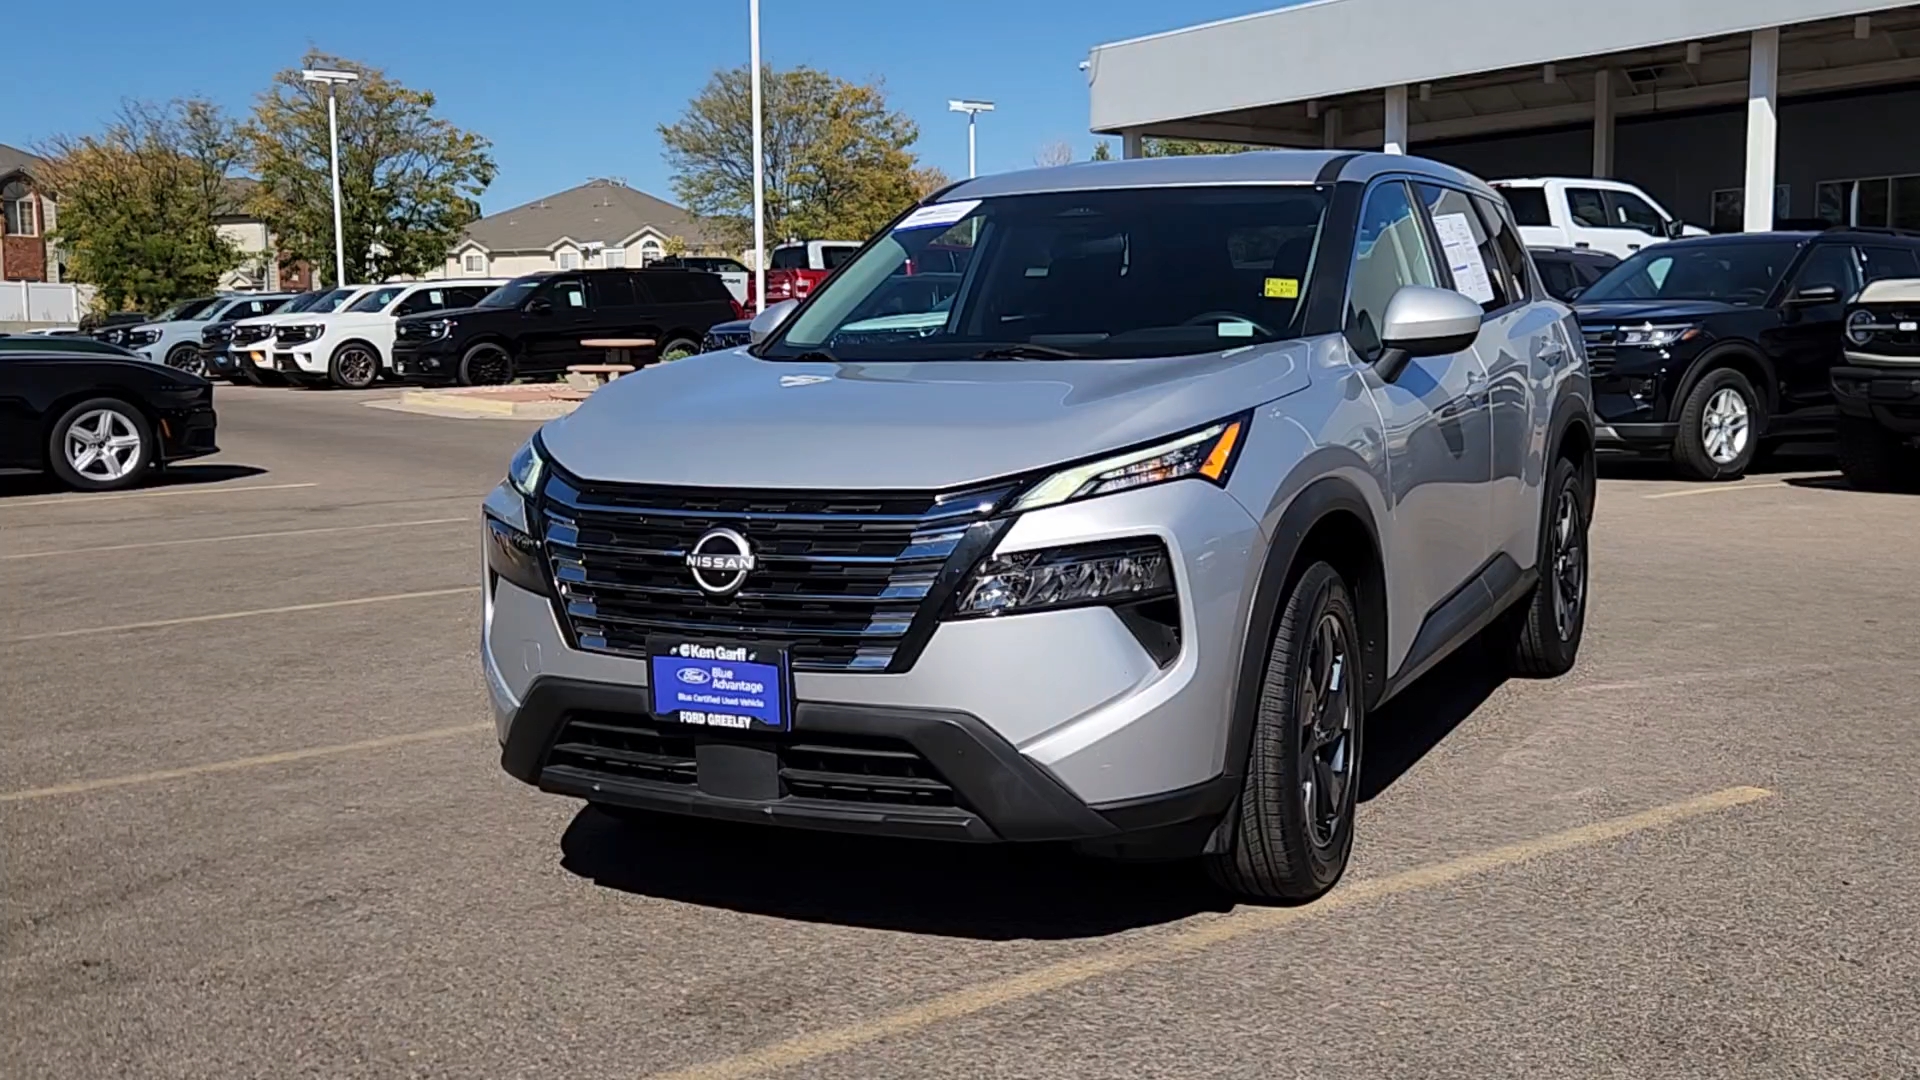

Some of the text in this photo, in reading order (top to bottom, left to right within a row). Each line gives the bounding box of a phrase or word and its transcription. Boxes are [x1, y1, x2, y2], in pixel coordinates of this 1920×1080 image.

[686, 555, 755, 570] NISSAN
[690, 644, 746, 662] Ken Garff
[680, 668, 707, 682] Ford
[711, 667, 733, 679] Blue
[712, 679, 764, 694] Advantage
[678, 692, 764, 708] Blue Certified Used Vehicle
[680, 711, 751, 730] FORD GREELEY
